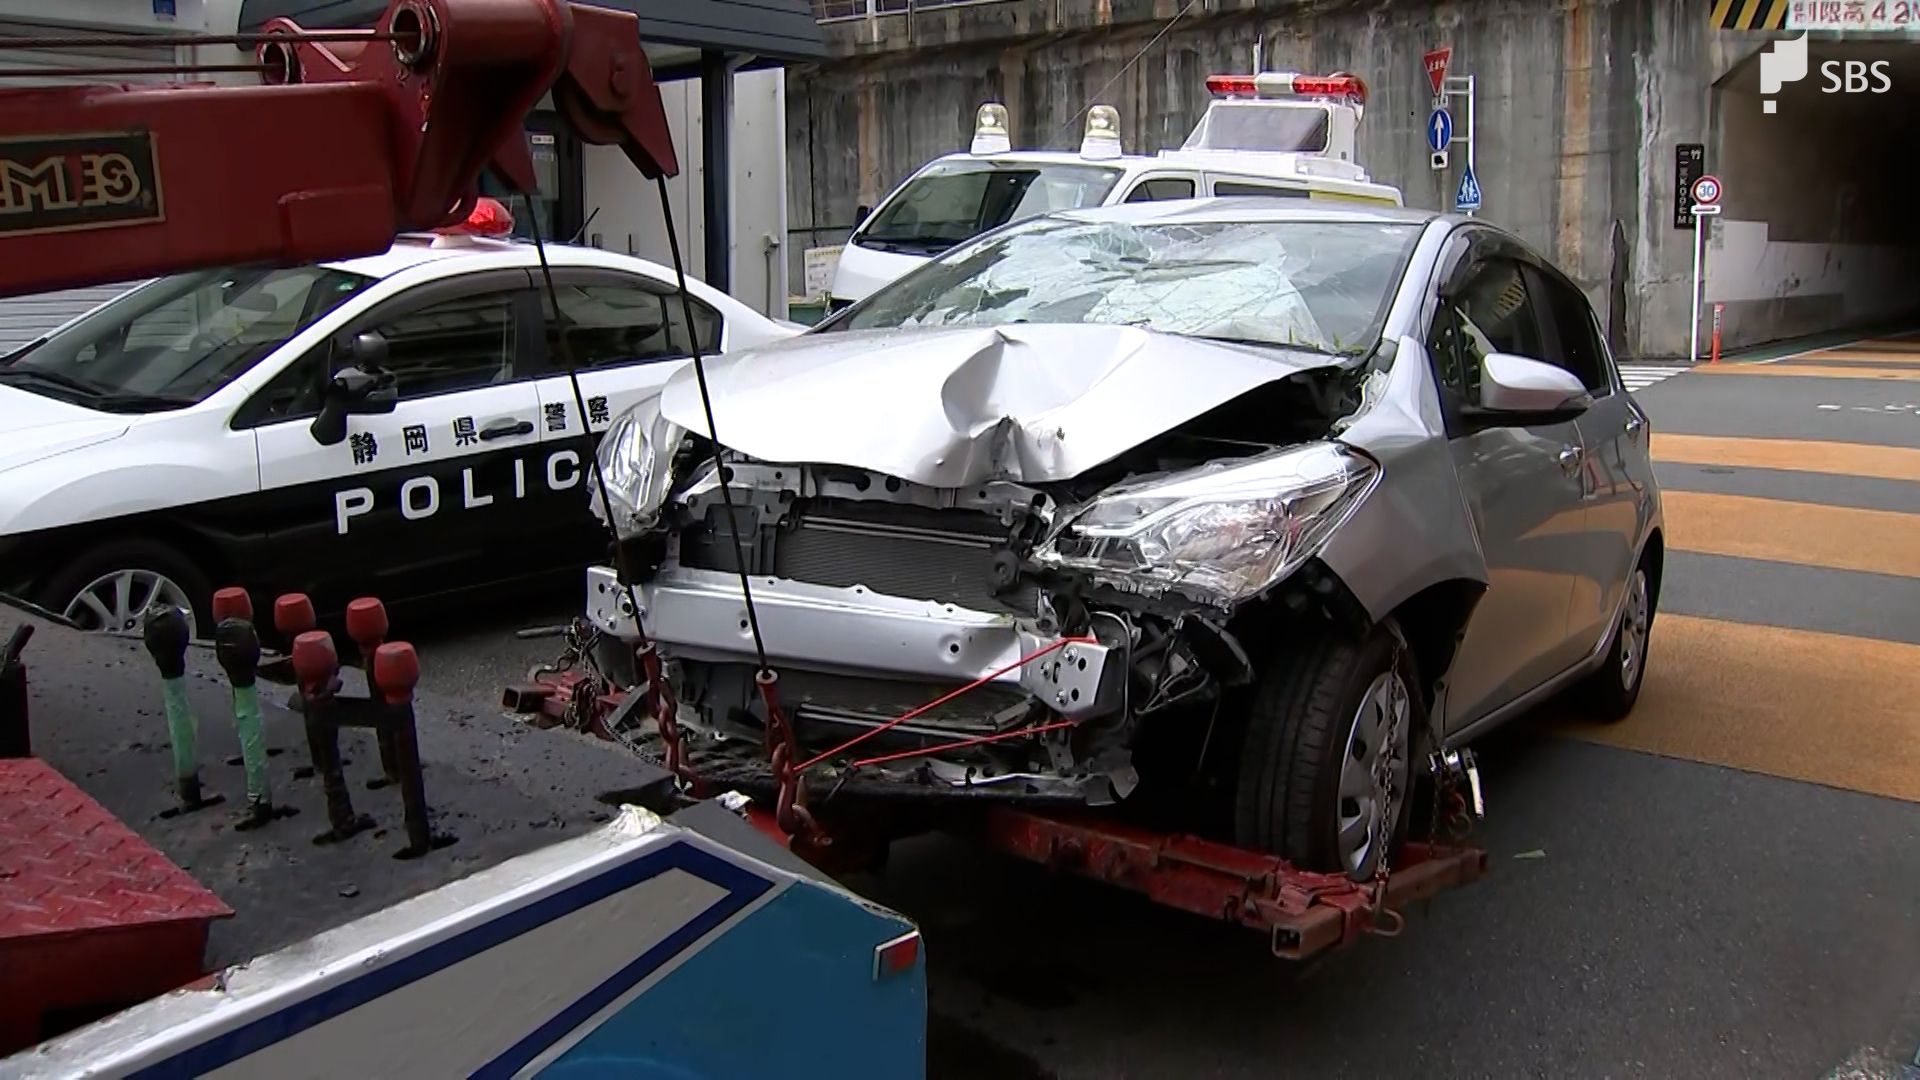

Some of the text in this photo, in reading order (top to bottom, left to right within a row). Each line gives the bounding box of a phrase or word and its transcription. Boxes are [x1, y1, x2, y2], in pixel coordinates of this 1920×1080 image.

[0, 152, 141, 214] MES
[1698, 184, 1715, 198] 30
[350, 394, 611, 466] 静岡県警察
[335, 449, 581, 534] POLIC
